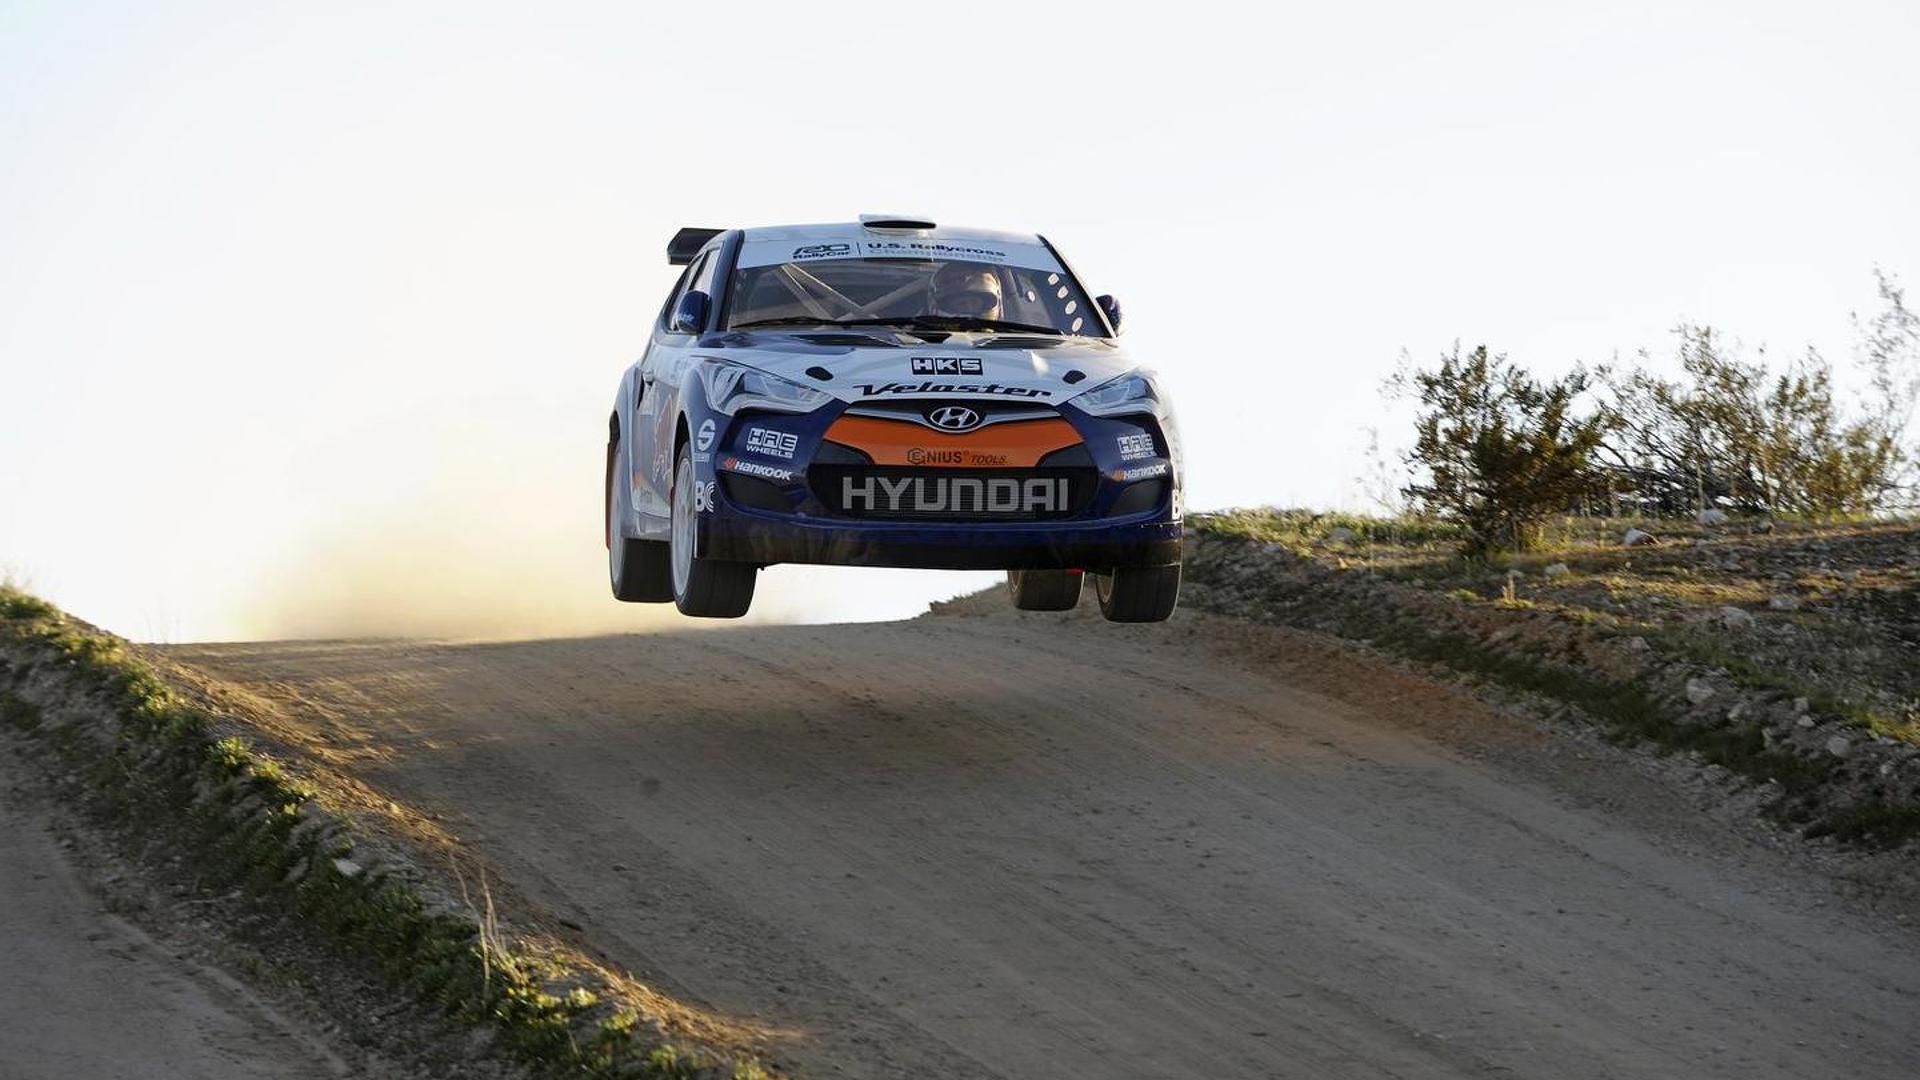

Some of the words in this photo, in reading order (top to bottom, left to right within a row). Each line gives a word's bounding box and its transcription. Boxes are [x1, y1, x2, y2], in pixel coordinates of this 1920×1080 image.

[910, 243, 1006, 257] Rallycross
[911, 358, 983, 374] HKS
[852, 381, 1052, 398] Veloster
[747, 427, 799, 452] HRE
[745, 444, 794, 460] WHEELS
[970, 454, 1007, 466] TOOLS
[842, 476, 1069, 512] HYUNDAI
